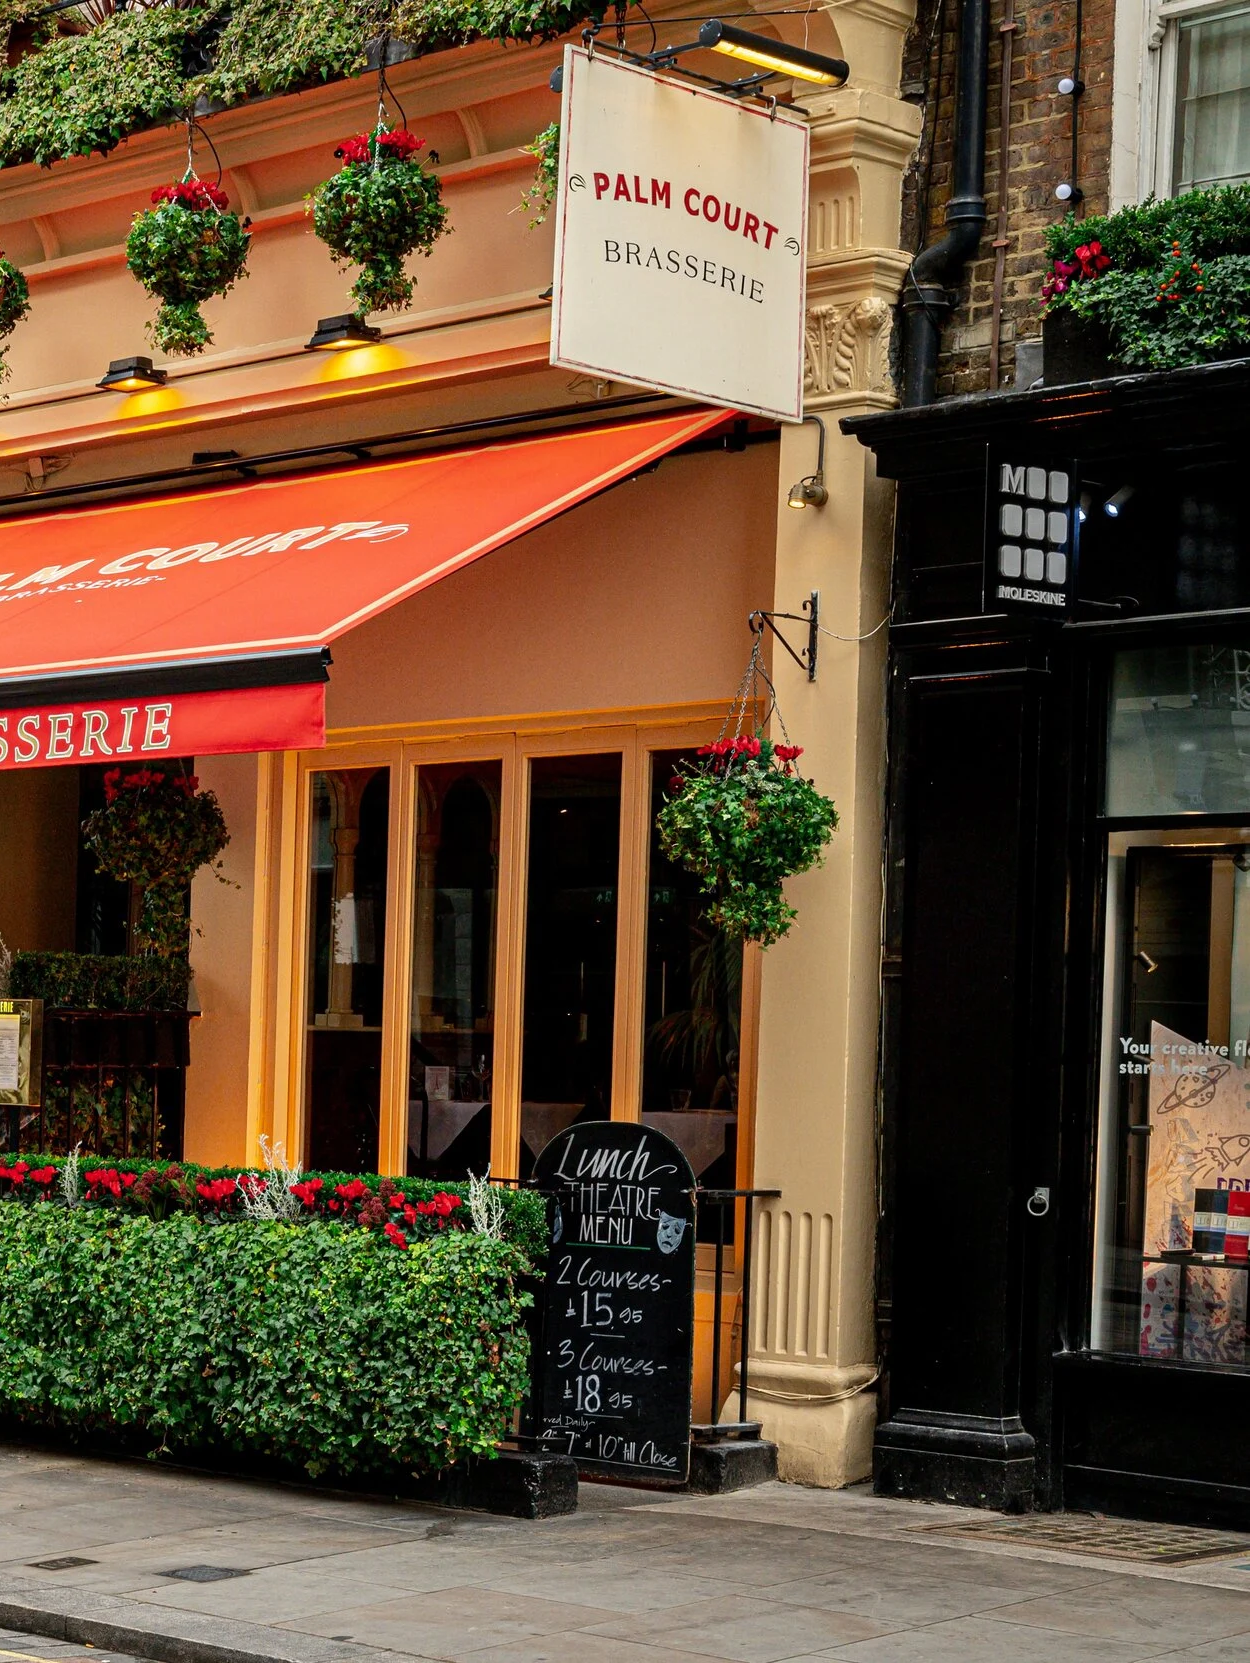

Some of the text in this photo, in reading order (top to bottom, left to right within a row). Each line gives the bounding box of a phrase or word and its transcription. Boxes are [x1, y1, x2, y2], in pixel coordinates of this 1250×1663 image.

[593, 172, 779, 250] PALM COURT
[604, 239, 764, 304] BRASSERIE
[98, 521, 383, 575] COURT
[998, 585, 1066, 607] MOLESKINE
[1119, 1037, 1156, 1055] Your
[1162, 1039, 1229, 1057] creative
[1119, 1058, 1208, 1076] starts here
[553, 1133, 678, 1182] Lunch
[564, 1182, 662, 1221] THEATRE
[579, 1214, 633, 1246] MENU
[556, 1255, 572, 1285] 2
[557, 1339, 575, 1368] 3
[623, 1441, 636, 1462] till
[639, 1440, 678, 1467] Close
